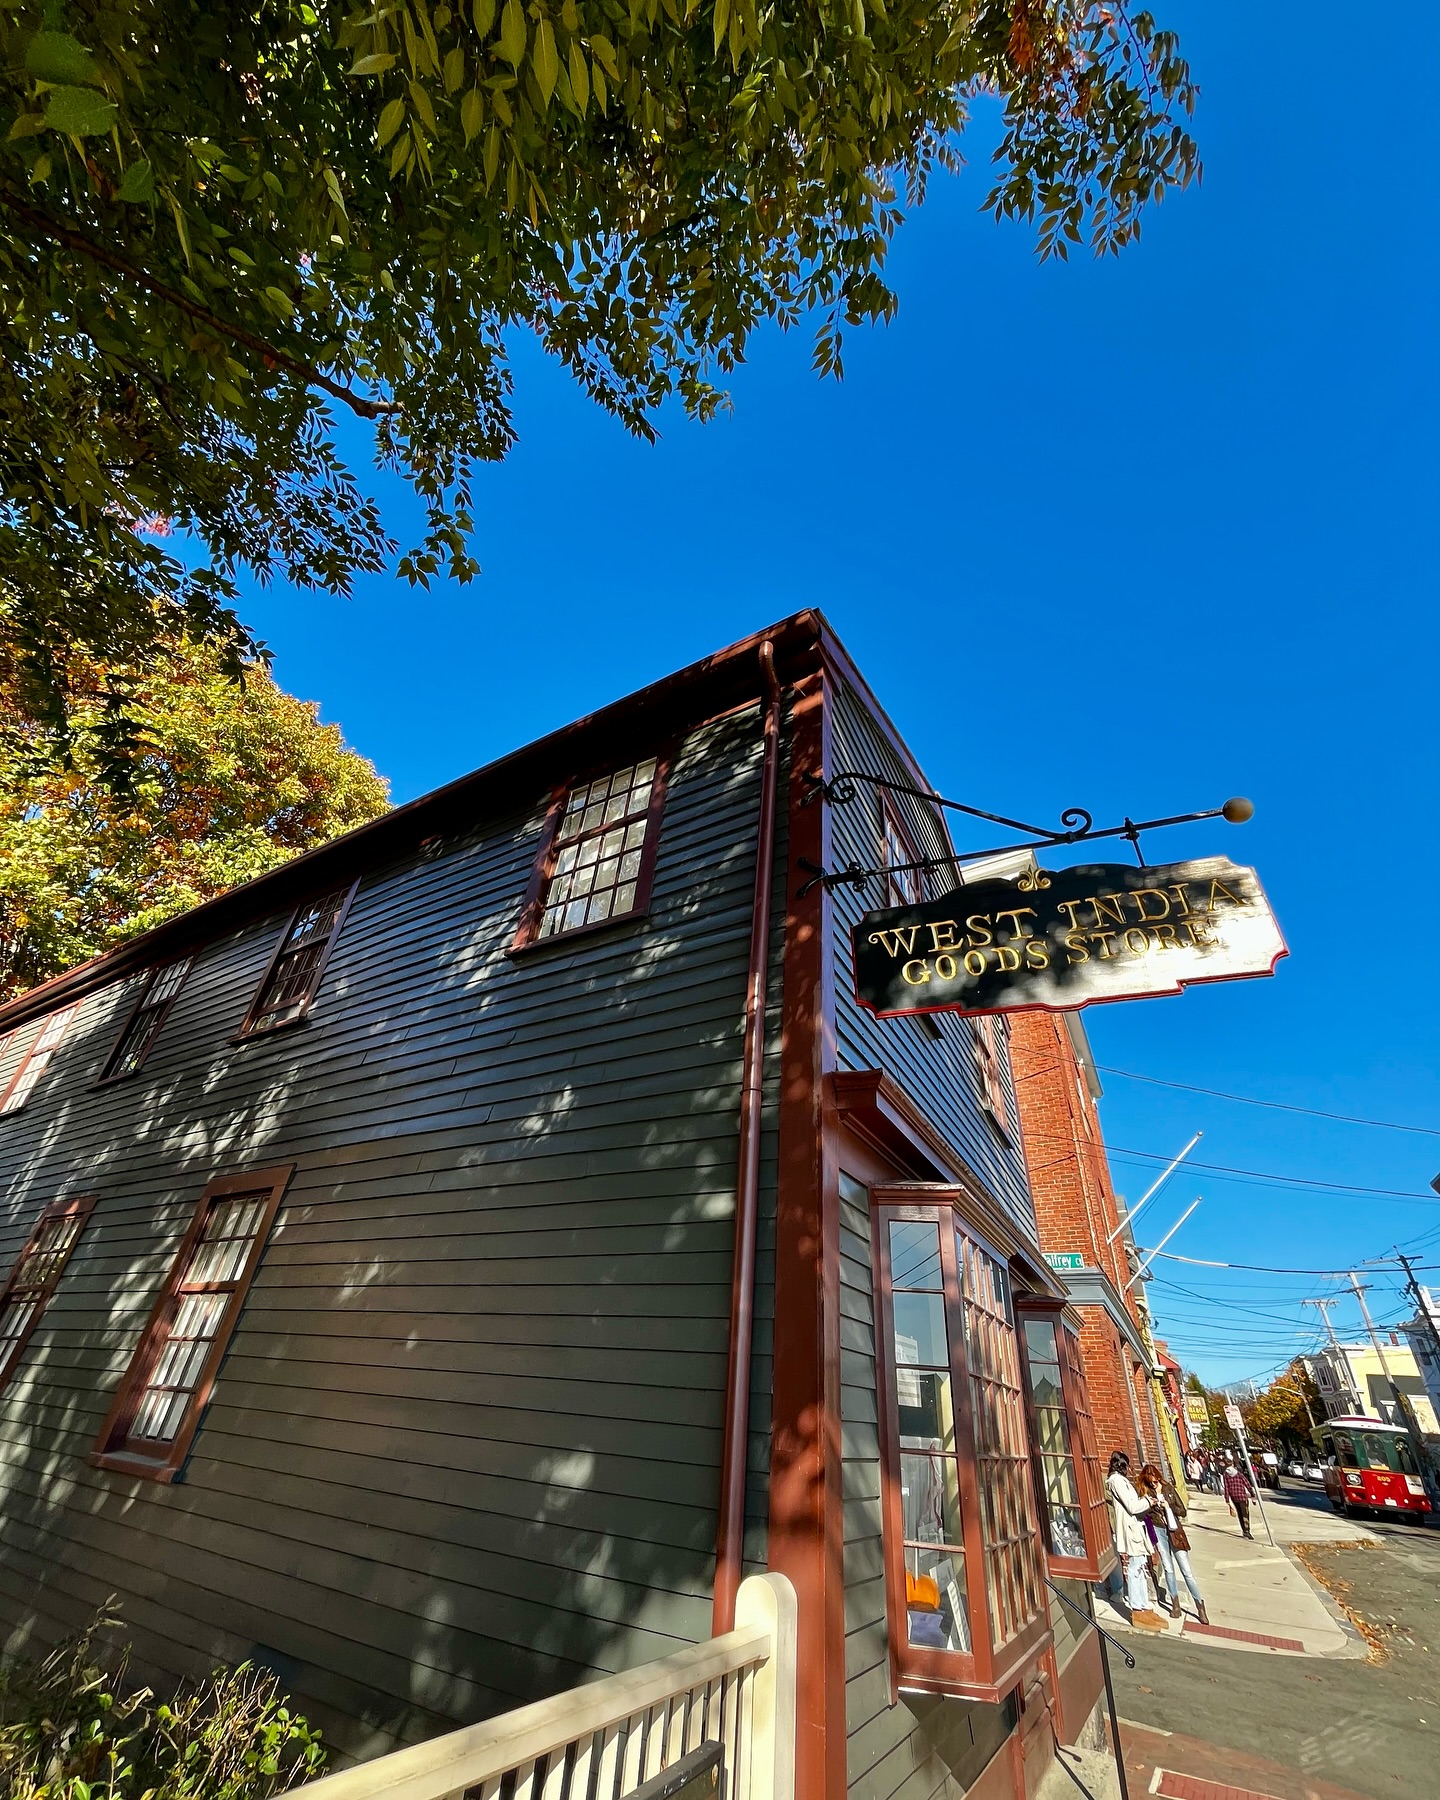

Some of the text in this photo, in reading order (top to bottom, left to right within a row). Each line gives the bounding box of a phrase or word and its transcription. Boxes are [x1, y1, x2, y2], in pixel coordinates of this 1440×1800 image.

[868, 879, 1246, 958] WEST INDIA
[902, 921, 1218, 985] GOODS STORE
[1045, 1255, 1071, 1269] alfrey
